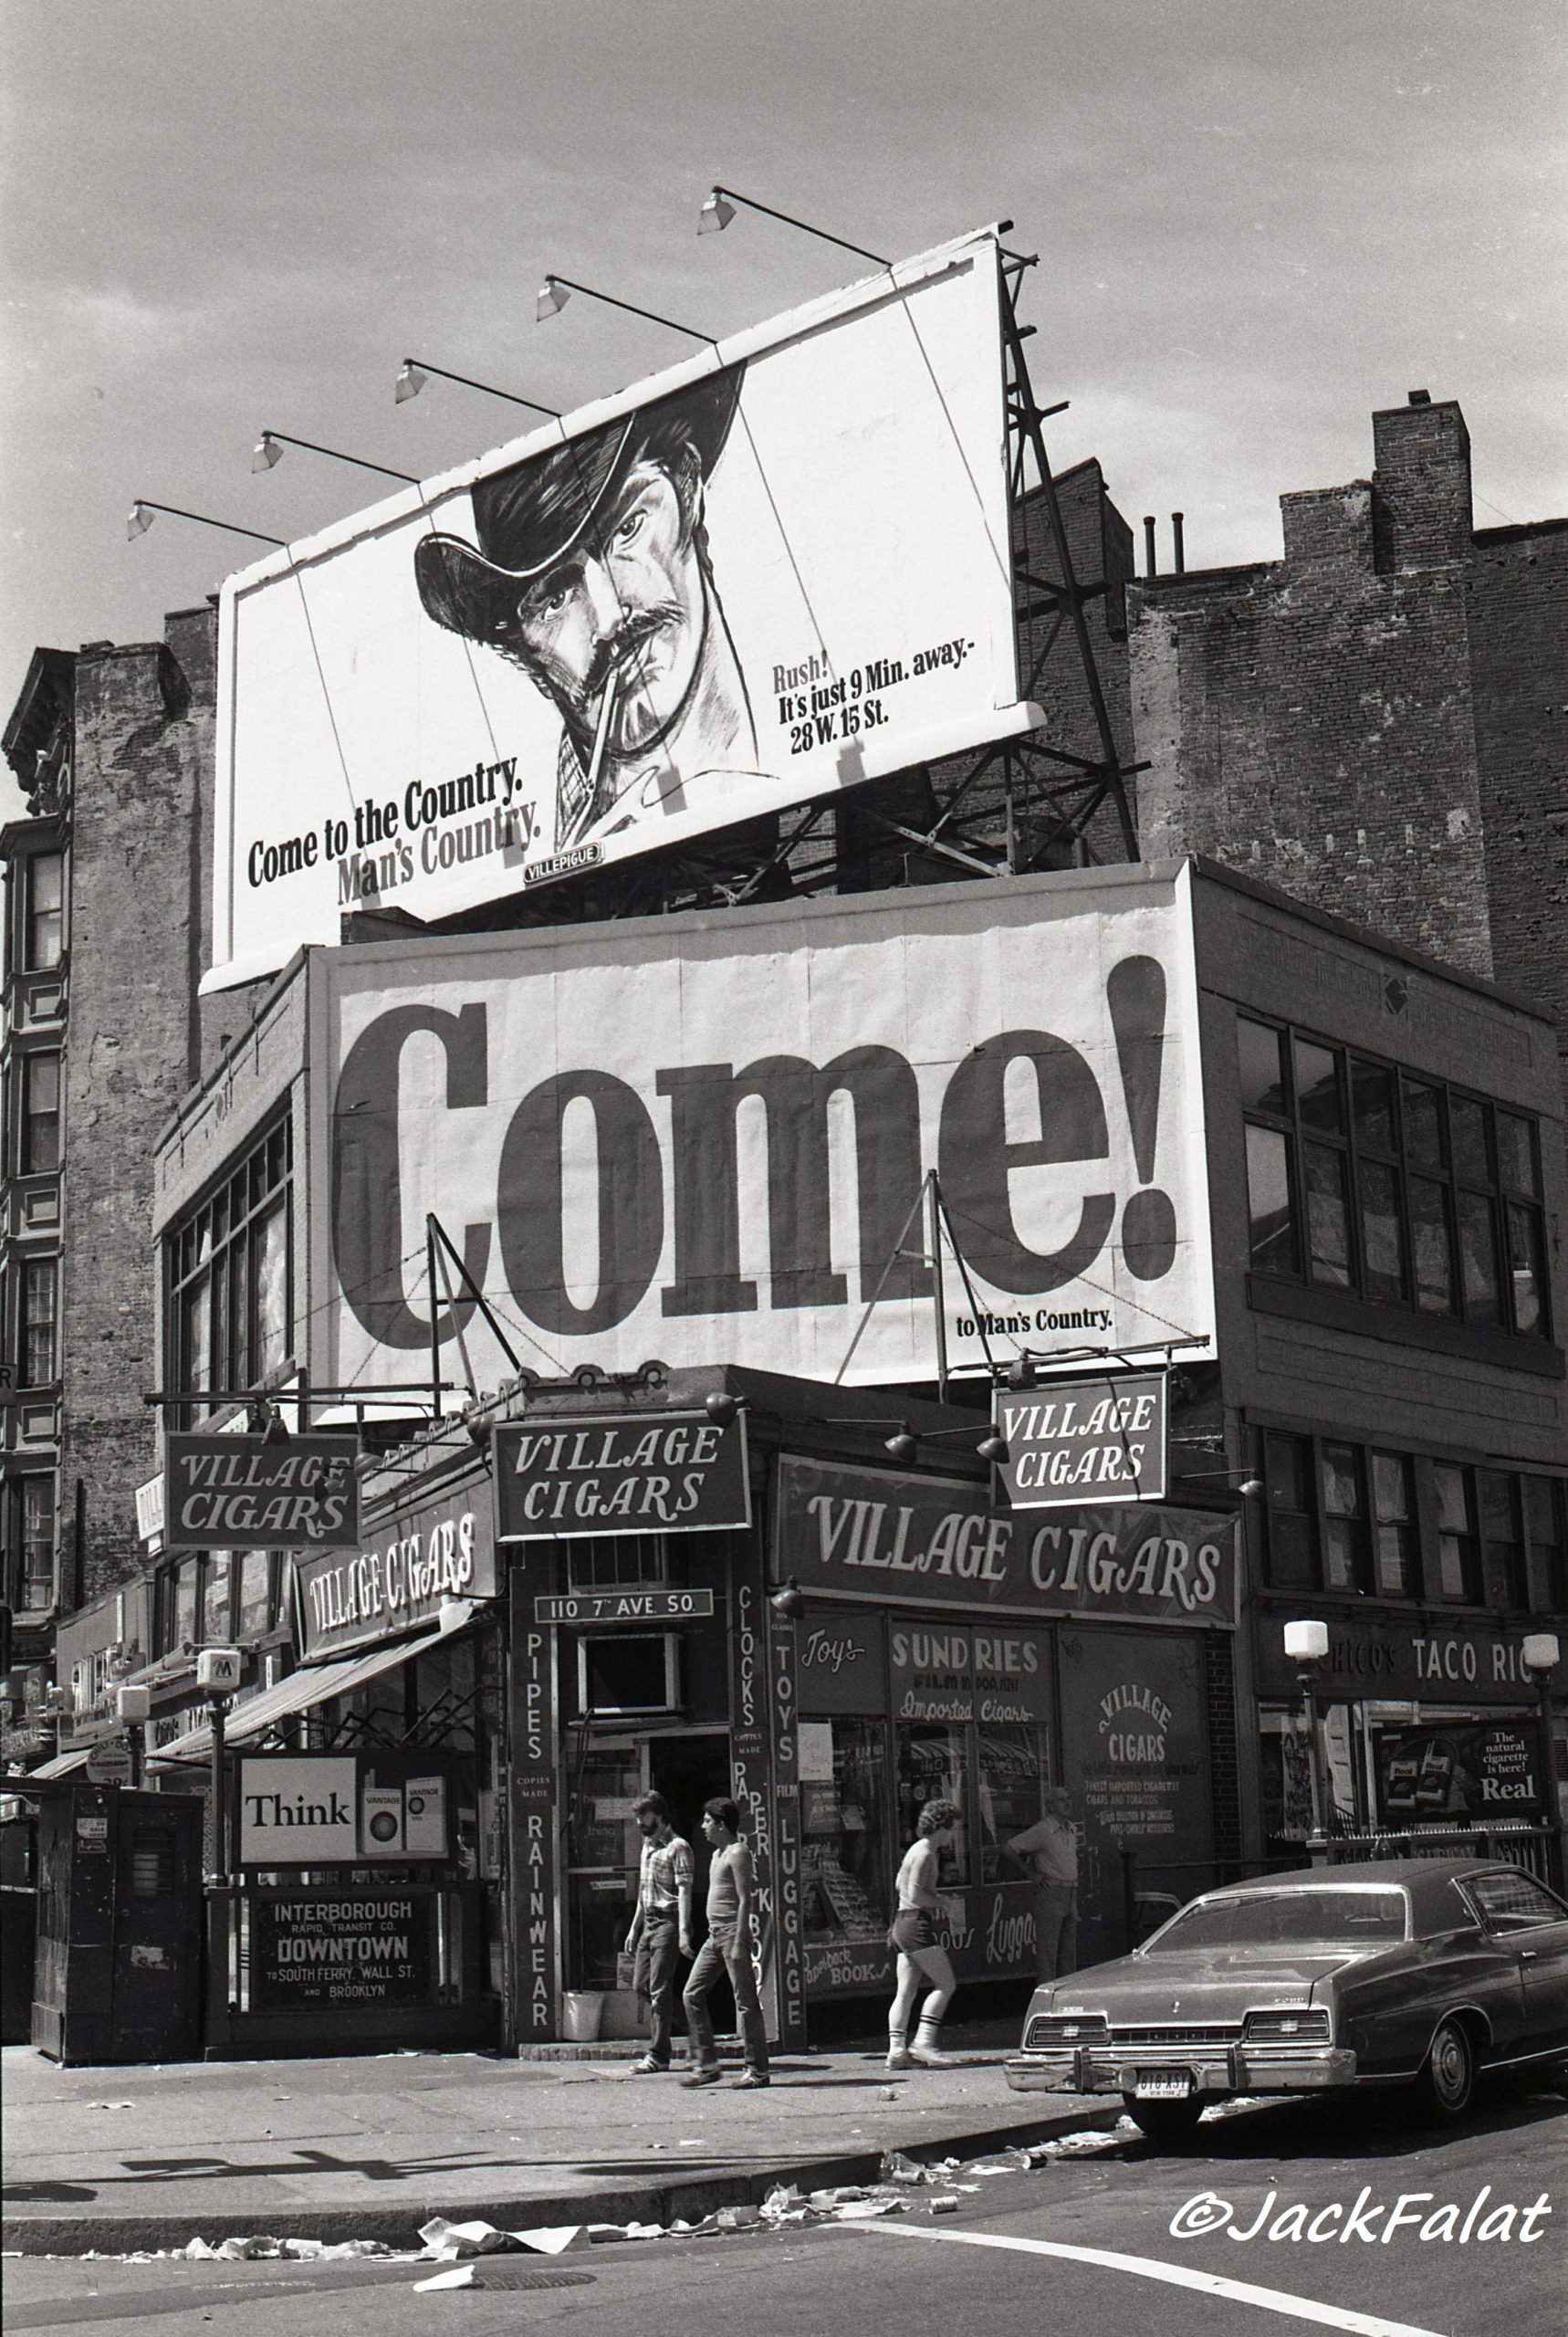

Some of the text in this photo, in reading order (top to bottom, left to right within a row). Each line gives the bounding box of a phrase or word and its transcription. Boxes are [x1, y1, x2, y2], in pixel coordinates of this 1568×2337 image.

[772, 651, 828, 695] Rush!
[779, 693, 807, 725] It's
[810, 677, 847, 718] just
[851, 669, 862, 699] 9
[865, 658, 910, 694] Min.
[790, 698, 889, 755] 28 W. 15 St.
[248, 757, 523, 888] Come to the Country.
[338, 801, 542, 907] Man's Country.
[528, 847, 594, 880] VILLEPIGUE
[331, 954, 1178, 1351] Come!
[956, 1307, 1113, 1337] to Man's Country.
[1003, 1394, 1157, 1444] VILLAGE
[515, 1425, 725, 1475] VILLAGE
[1015, 1443, 1146, 1489] CIGARS
[180, 1454, 351, 1490] VILLAGE
[181, 1492, 350, 1539] CIGARS
[524, 1471, 706, 1523] CIGARS
[309, 1512, 476, 1632] VILLAGE CIGARS
[805, 1495, 1221, 1611] VILLAGE CIGARS
[551, 1600, 578, 1618] 110
[617, 1597, 657, 1616] AVE.
[668, 1594, 695, 1613] SO.
[738, 1585, 755, 1727] CLOCKS
[801, 1630, 865, 1673] Toys
[891, 1632, 1039, 1673] SUNDRIES
[1411, 1638, 1478, 1682] TACO
[1491, 1642, 1534, 1685] RIC
[527, 1633, 543, 1760] PIPES
[776, 1645, 794, 1762] TOYS
[899, 1690, 1035, 1724] Imported Cigars
[1098, 1683, 1174, 1734] VILLAGE
[1108, 1734, 1166, 1763] CIGARS
[1483, 1752, 1530, 1765] cigarette
[1486, 1740, 1525, 1753] natural
[1492, 1732, 1515, 1743] The
[1480, 1774, 1537, 1801] Real
[1488, 1761, 1526, 1775] is here!
[246, 1792, 352, 1828] Think
[365, 1797, 401, 1805] VANTAGE
[776, 1784, 799, 1798] FILM
[274, 1902, 413, 1923] INTERBOROUGH
[291, 1921, 397, 1934] RAPID TRANSIT CO.
[527, 1814, 549, 2028] RAINWEAR
[782, 1818, 801, 2027] LUGGAGE
[277, 1935, 409, 1964] DOWNTOWN
[267, 1971, 277, 1980] TO
[277, 1967, 316, 1982] SOUTH
[361, 1965, 393, 1979] WALL
[397, 1964, 416, 1978] ST.
[304, 1984, 386, 1998] AND BROOKLYN
